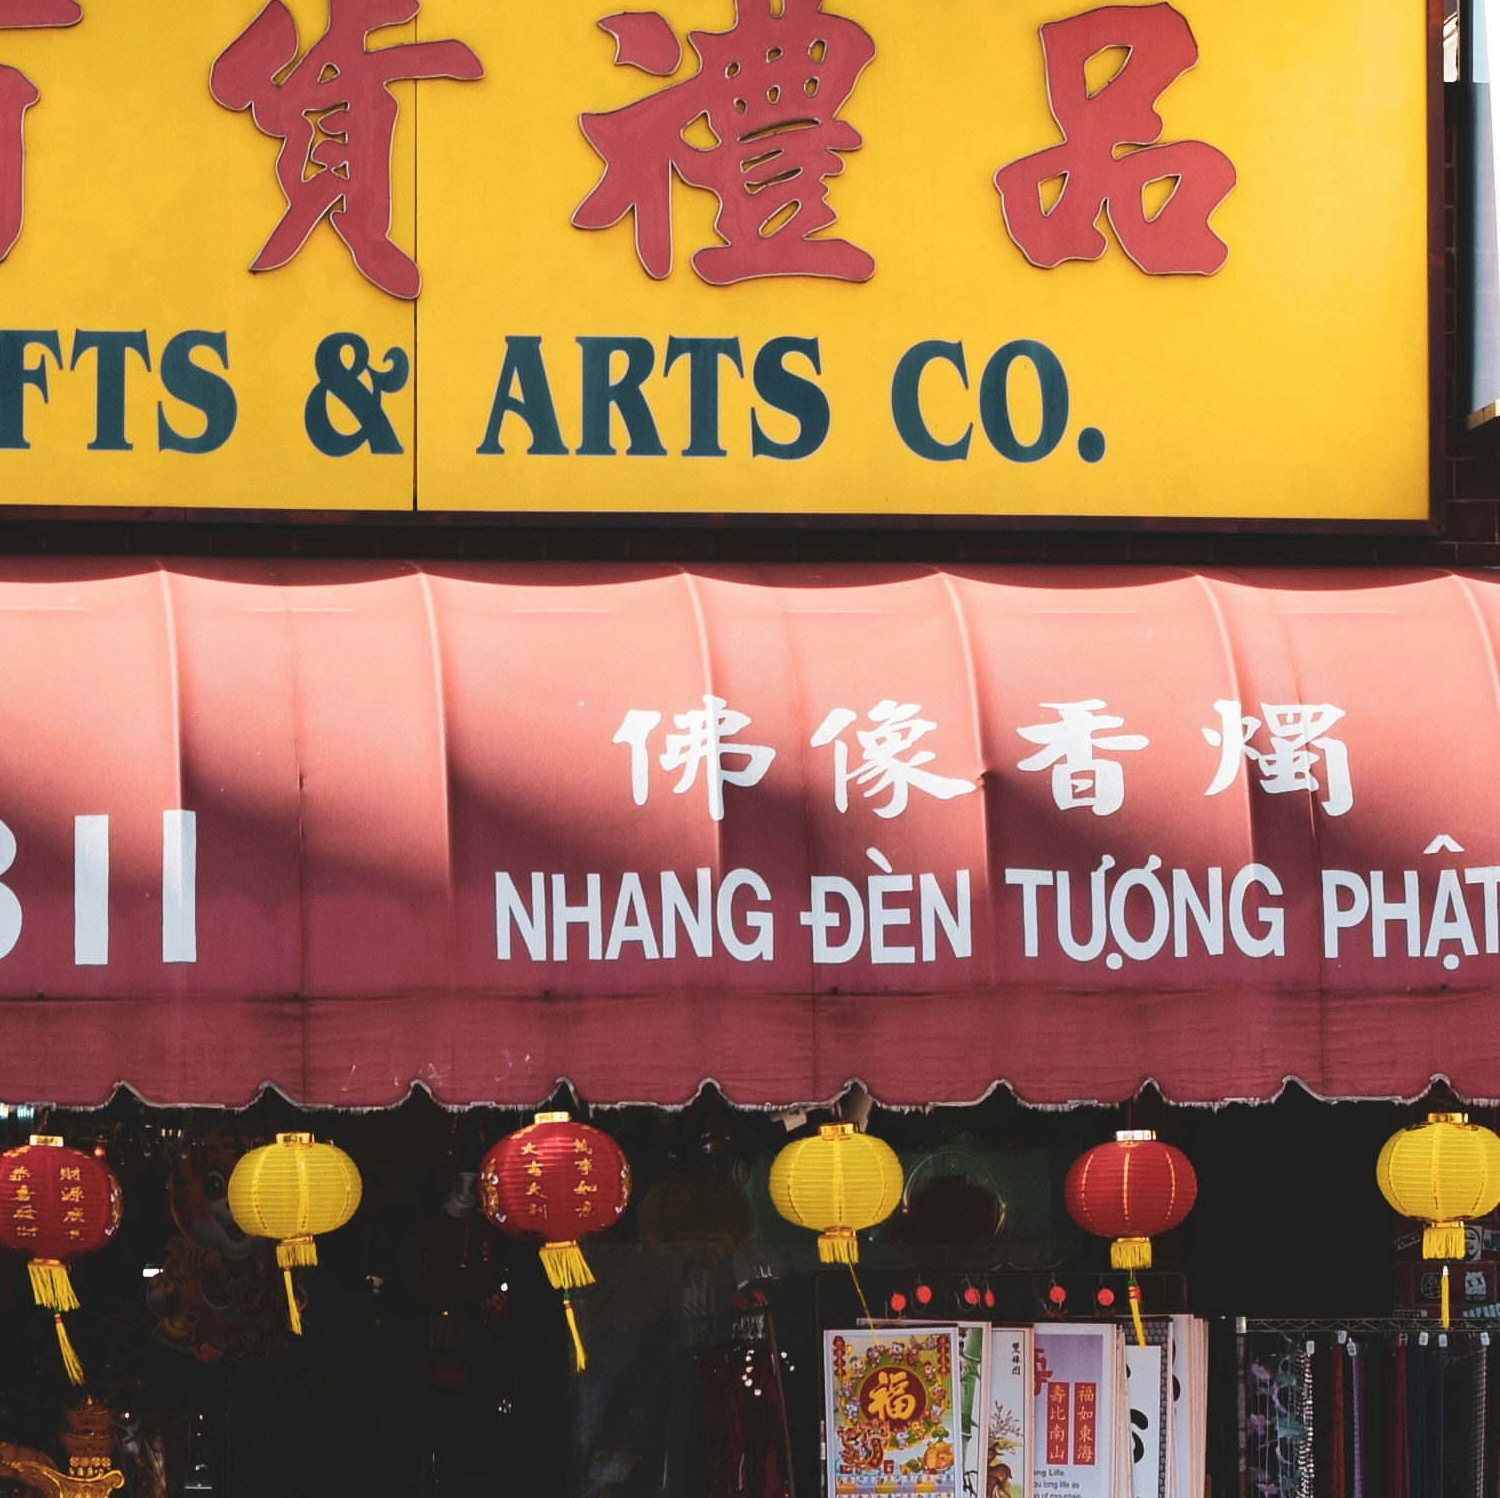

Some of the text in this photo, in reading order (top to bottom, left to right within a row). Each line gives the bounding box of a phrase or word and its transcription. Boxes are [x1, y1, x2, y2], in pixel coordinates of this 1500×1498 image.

[305, 332, 409, 458] &
[476, 334, 832, 459] ARTS
[891, 338, 1107, 464] CO.
[612, 694, 1354, 821] 佛像香燭
[493, 867, 775, 964] NHANG
[800, 846, 973, 965] ĐÈN
[1005, 854, 1286, 971] TƯỢNG
[869, 1371, 916, 1420] 福
[1049, 1384, 1066, 1461] 壽比南山
[1077, 1386, 1094, 1463] 福如東海
